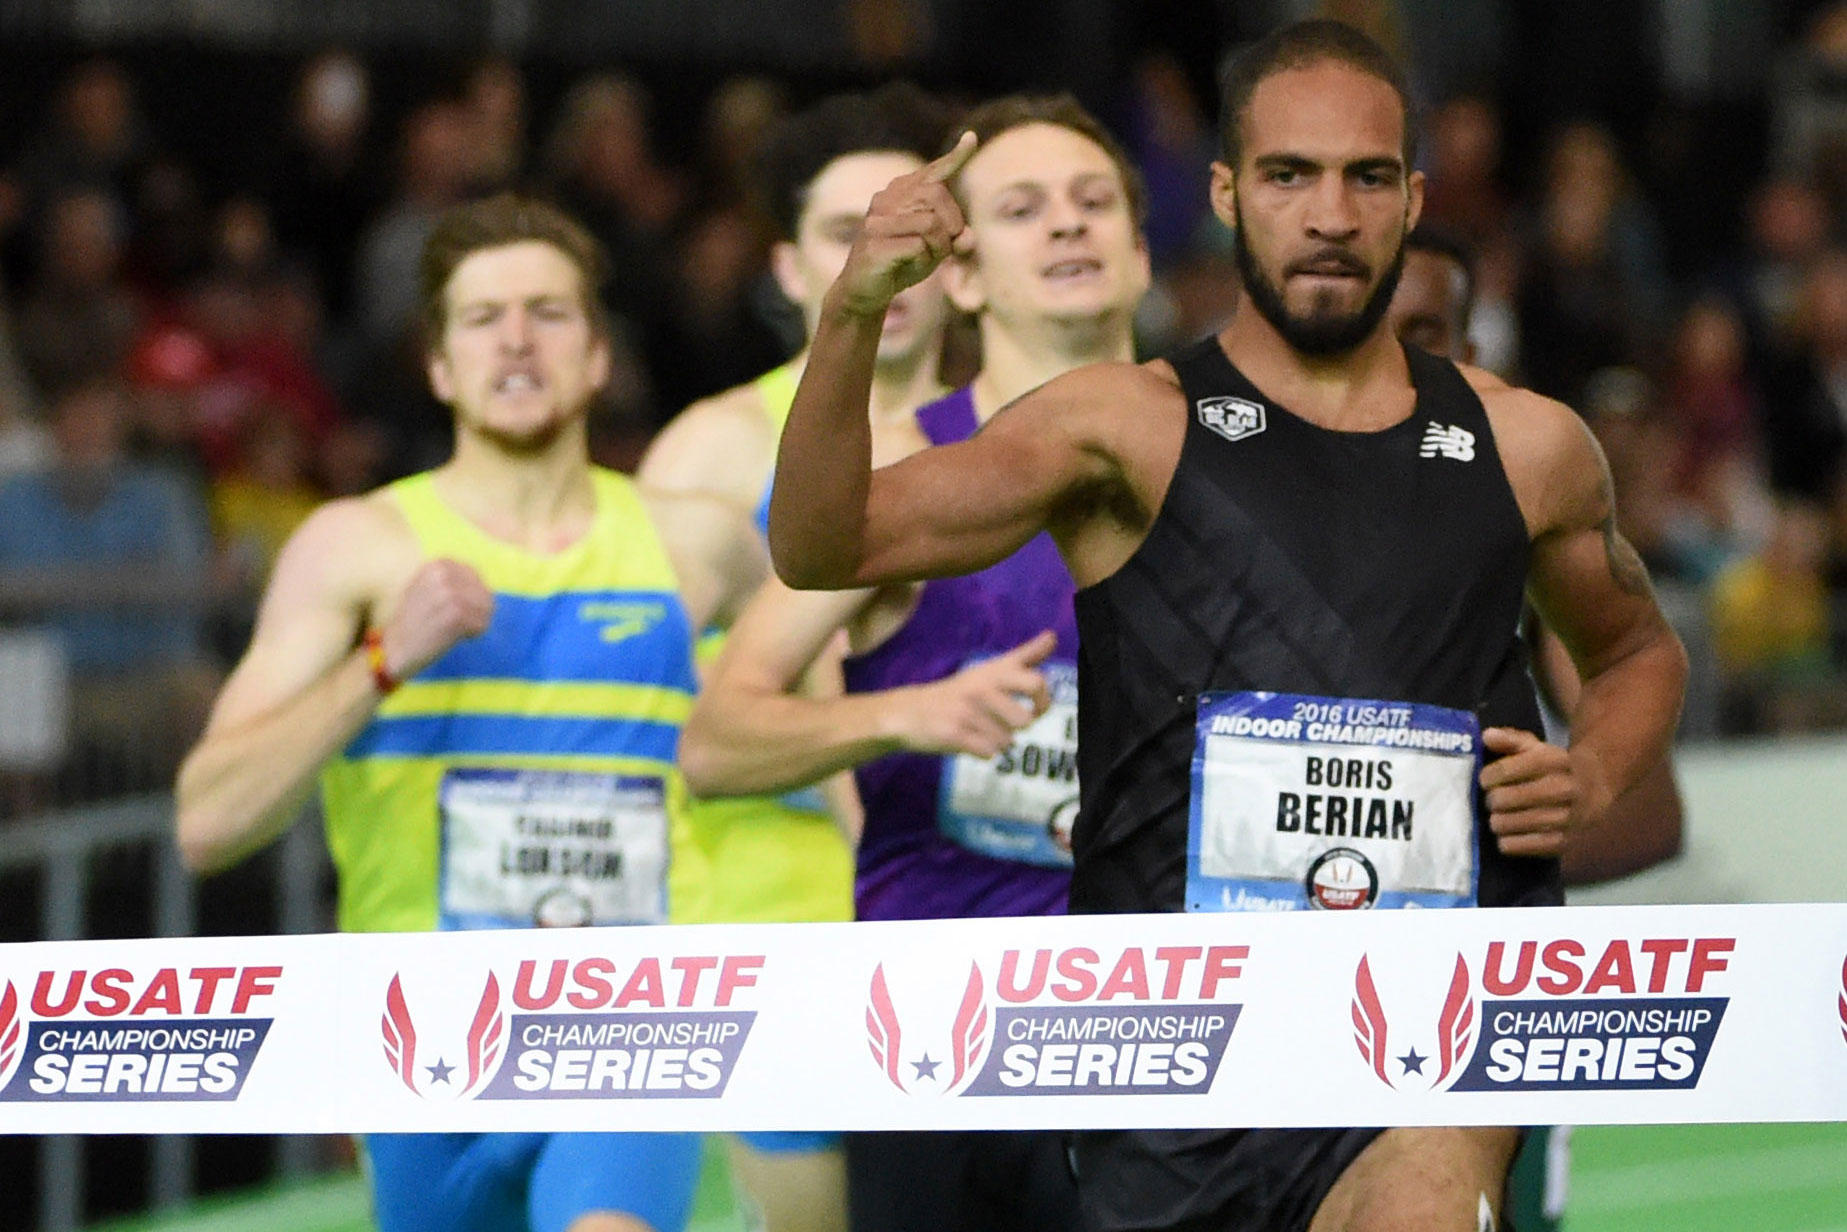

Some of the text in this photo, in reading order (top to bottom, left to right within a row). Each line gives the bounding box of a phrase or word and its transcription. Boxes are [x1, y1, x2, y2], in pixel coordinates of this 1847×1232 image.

[1211, 715, 1473, 752] INDOOR CHAMPIONSHIPS
[1294, 702, 1412, 727] 2016 USATF
[1306, 756, 1393, 791] BORIS
[1276, 791, 1414, 841] BERIAN
[512, 955, 766, 1010] USATF
[996, 945, 1250, 1003] USATF
[1482, 938, 1736, 996] USATF
[31, 966, 283, 1017] USATF
[39, 1028, 256, 1051] CHAMPIONSHIP
[522, 1022, 739, 1046] CHAMPIONSHIP
[1007, 1016, 1224, 1040] CHAMPIONSHIP
[1493, 1009, 1712, 1035] CHAMPIONSHIP
[29, 1052, 239, 1093] SERIES
[513, 1048, 723, 1092] SERIES
[998, 1042, 1209, 1087] SERIES
[1485, 1036, 1696, 1082] SERIES
